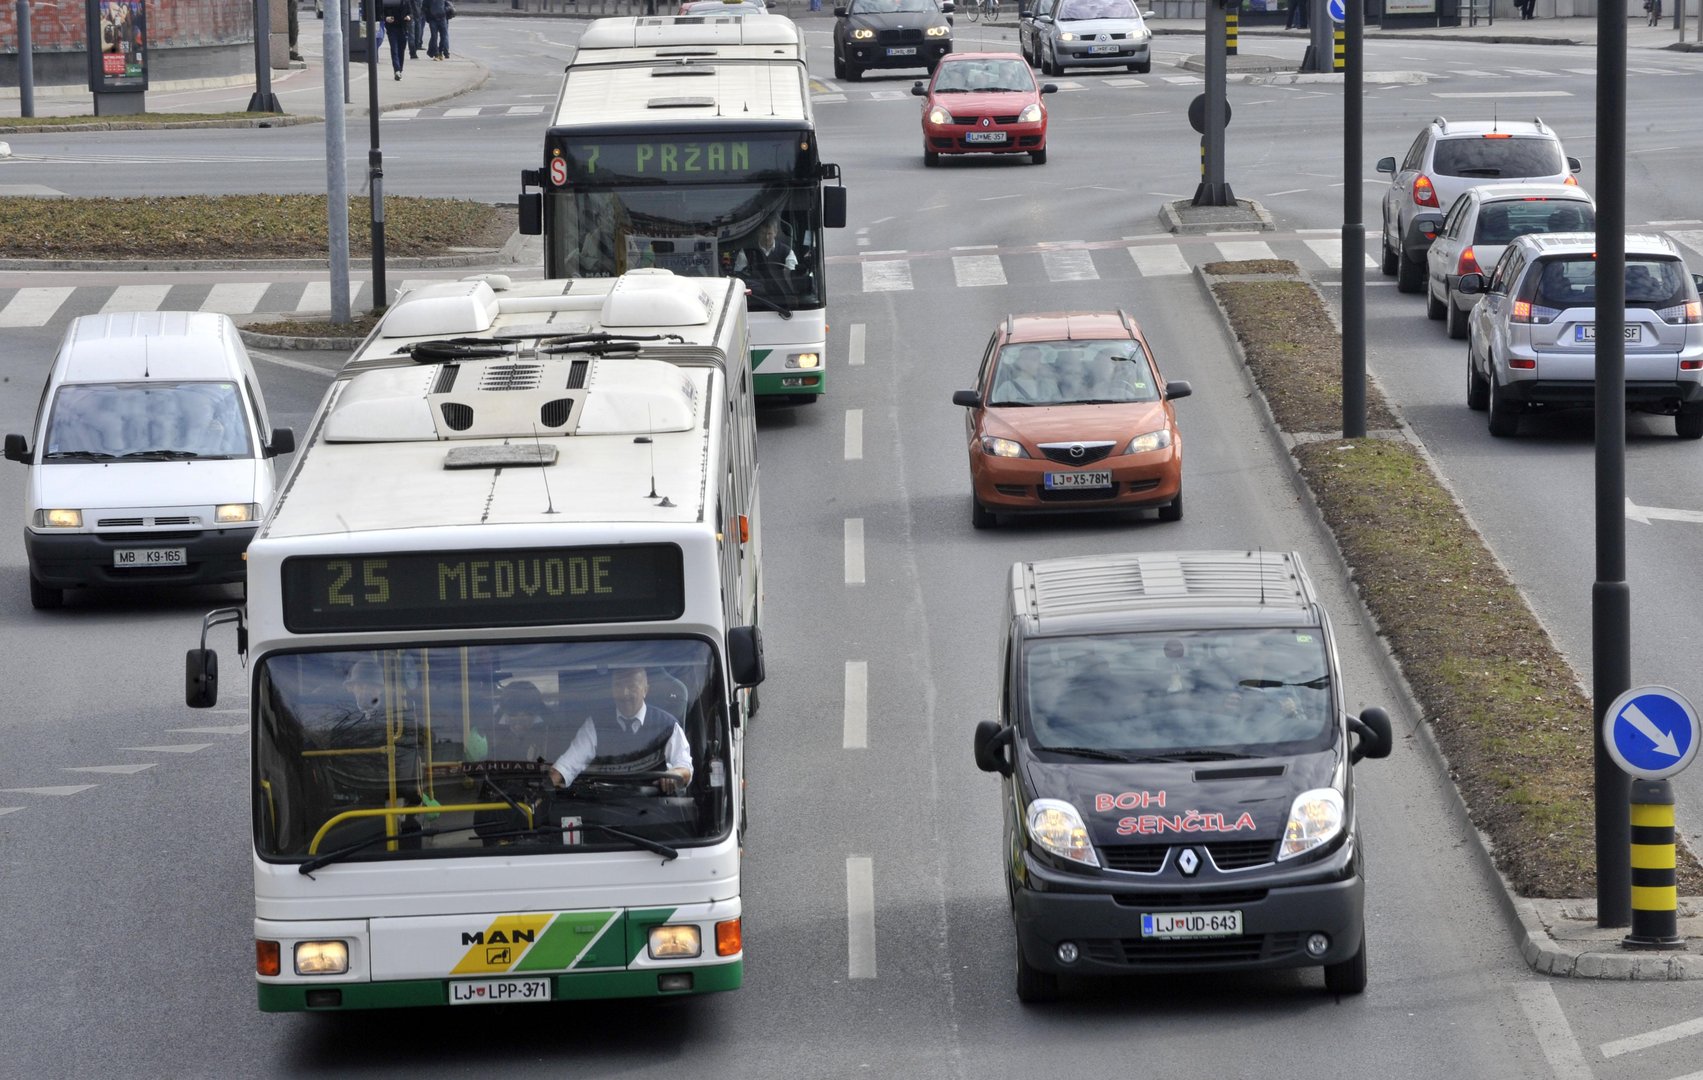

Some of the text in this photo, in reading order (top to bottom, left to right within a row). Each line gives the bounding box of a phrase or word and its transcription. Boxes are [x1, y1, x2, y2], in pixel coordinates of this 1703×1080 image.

[582, 142, 749, 174] 7 PRŽAN
[552, 158, 566, 184] S
[1053, 473, 1109, 486] LJ X5-78M
[119, 550, 181, 563] MB K9-165
[327, 556, 613, 606] 25 MEDVODE
[1095, 790, 1167, 812] BOH
[1116, 810, 1257, 836] SENČILA
[1156, 915, 1237, 932] LJ UD-643
[461, 929, 535, 945] MAN
[454, 981, 546, 1000] LJ LPP-371
